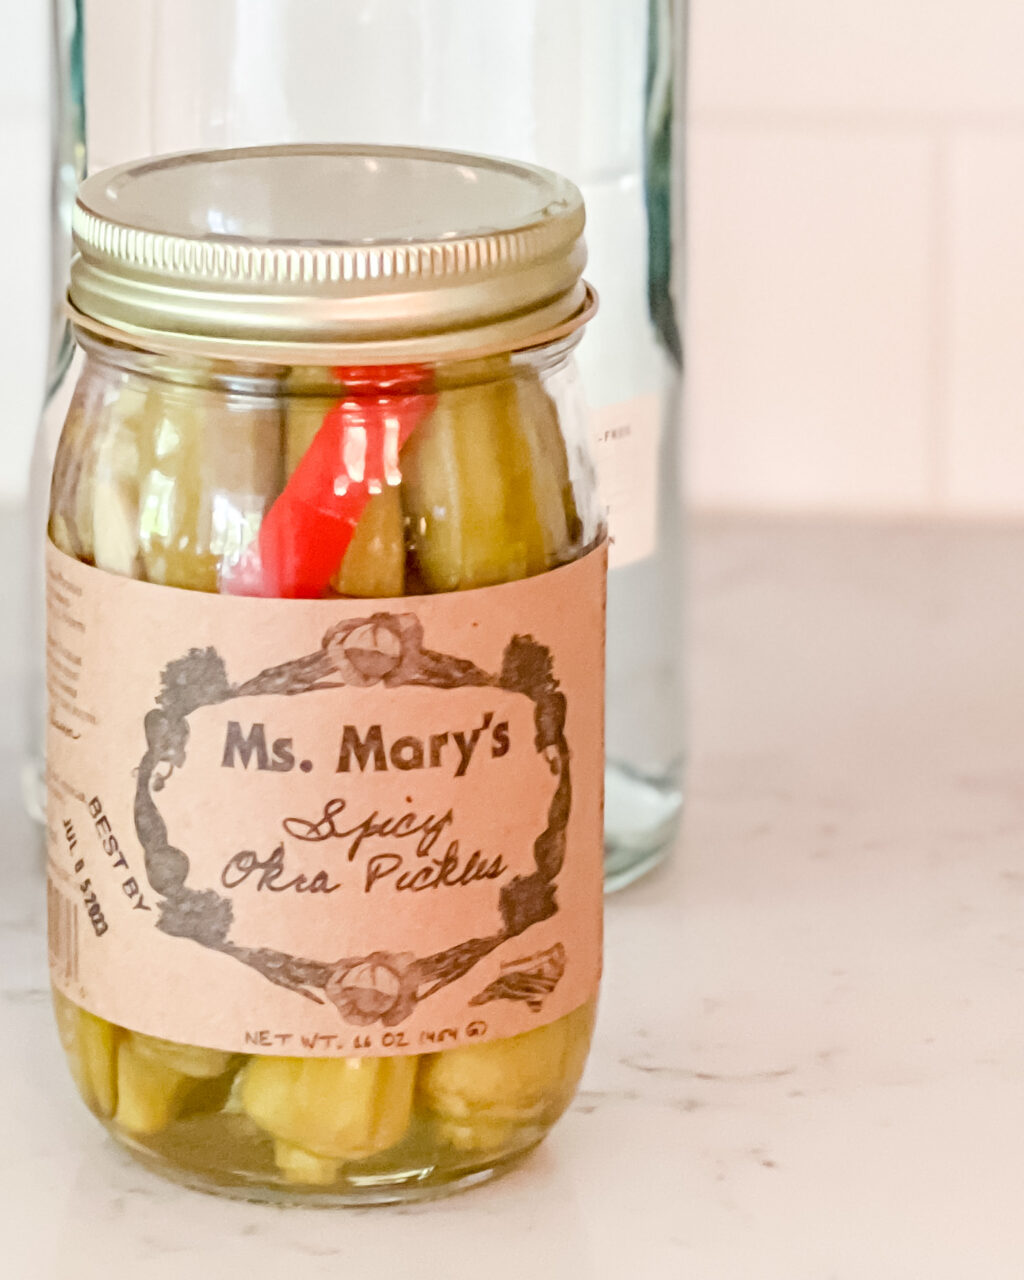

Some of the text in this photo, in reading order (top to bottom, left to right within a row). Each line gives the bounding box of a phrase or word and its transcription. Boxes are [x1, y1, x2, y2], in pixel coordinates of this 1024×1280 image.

[220, 711, 511, 778] Ms. Mary's
[89, 796, 152, 911] BEST BY
[283, 796, 455, 865] Spicy
[220, 841, 509, 895] Okra Pickles
[244, 1029, 294, 1048] NET
[381, 1031, 411, 1048] OZ
